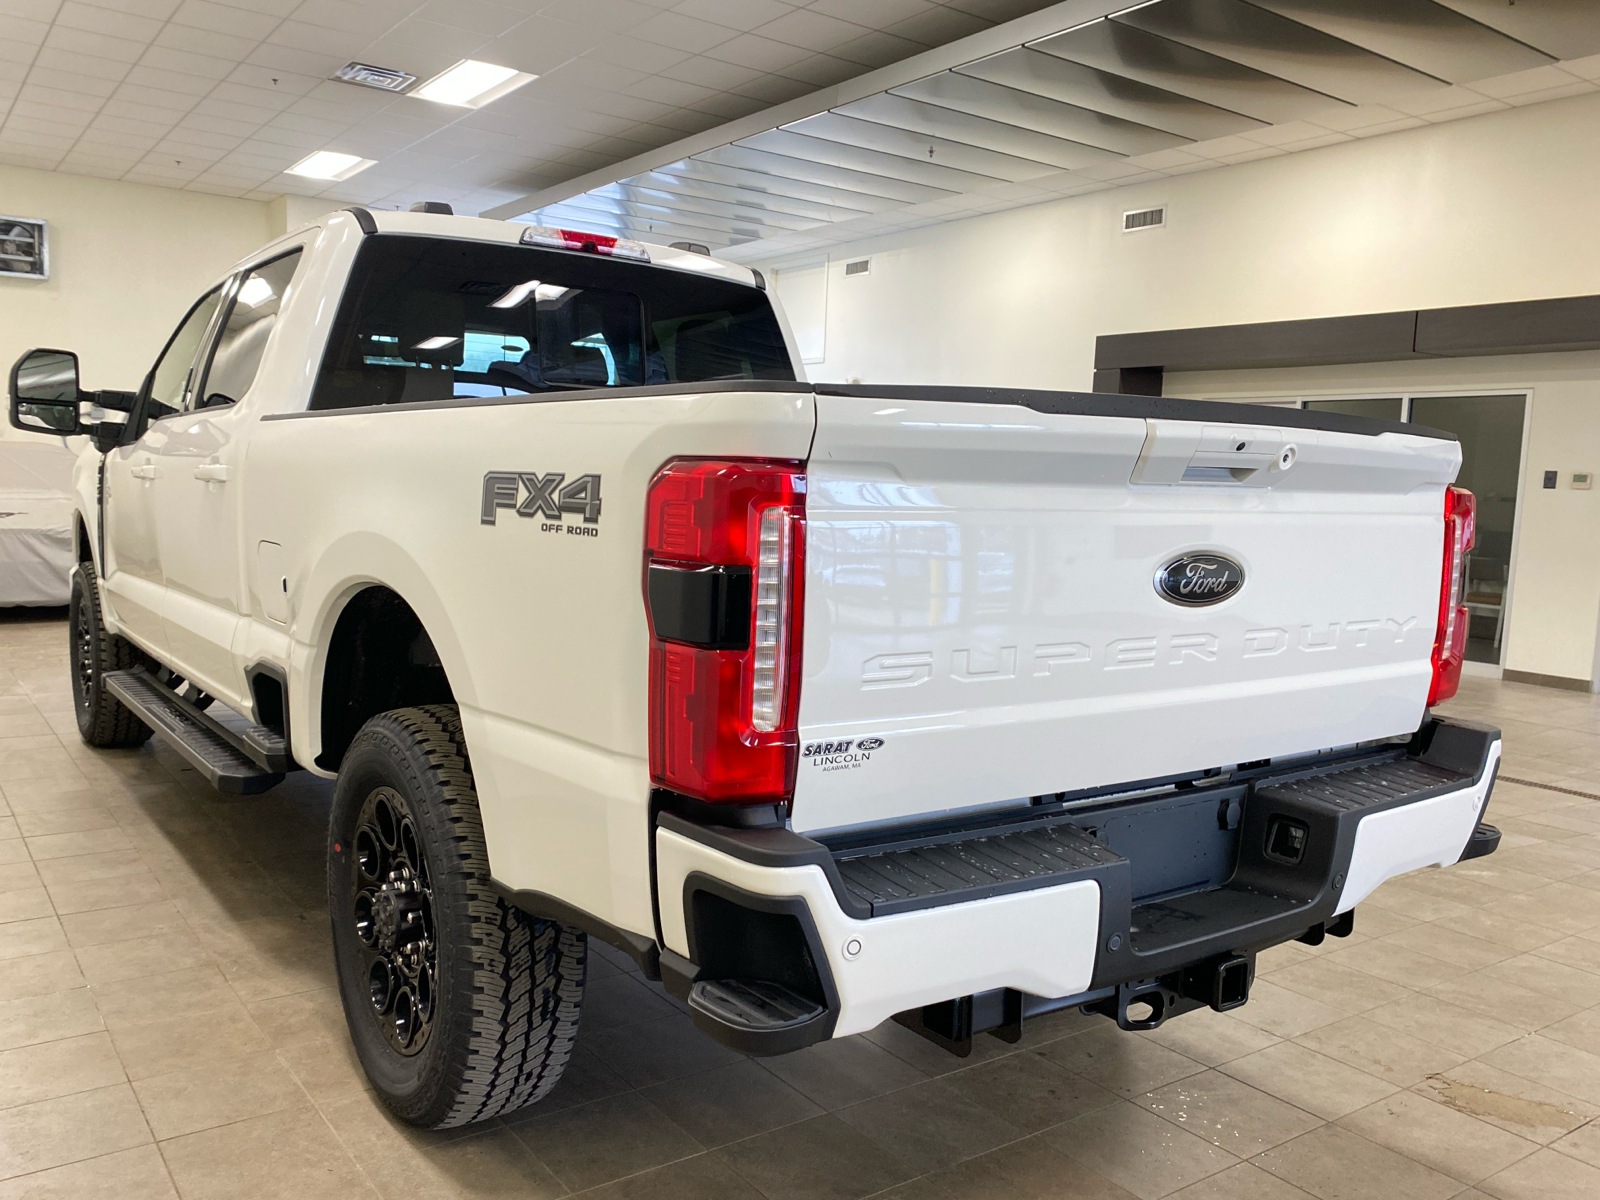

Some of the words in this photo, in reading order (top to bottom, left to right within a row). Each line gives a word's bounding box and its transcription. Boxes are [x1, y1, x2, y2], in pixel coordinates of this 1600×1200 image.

[480, 470, 602, 526] FX4
[540, 523, 563, 533] OFF
[566, 525, 599, 538] ROAD
[1180, 562, 1229, 594] Ford
[861, 632, 1219, 691] SUPER
[1243, 615, 1418, 659] DUTY
[802, 739, 854, 758] SARAT
[813, 752, 871, 767] LINCOLN
[822, 764, 850, 772] AGAWAM,
